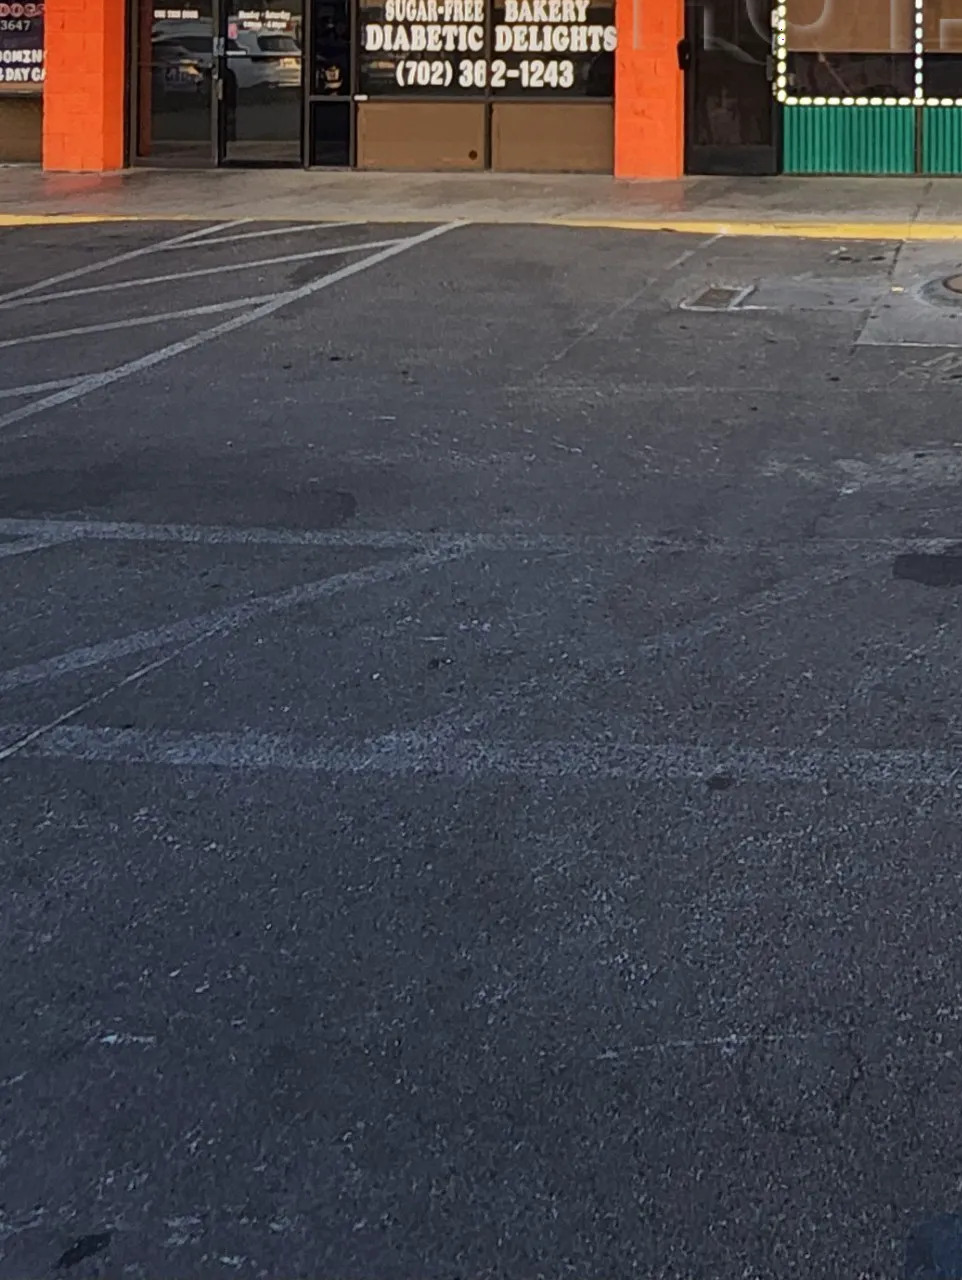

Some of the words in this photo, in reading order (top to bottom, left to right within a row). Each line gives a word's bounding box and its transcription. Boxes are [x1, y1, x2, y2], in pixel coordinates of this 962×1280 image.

[365, 24, 484, 51] DIABETIC
[495, 24, 618, 52] DELIGHTS
[5, 67, 30, 81] DAY
[396, 60, 453, 87] (702)
